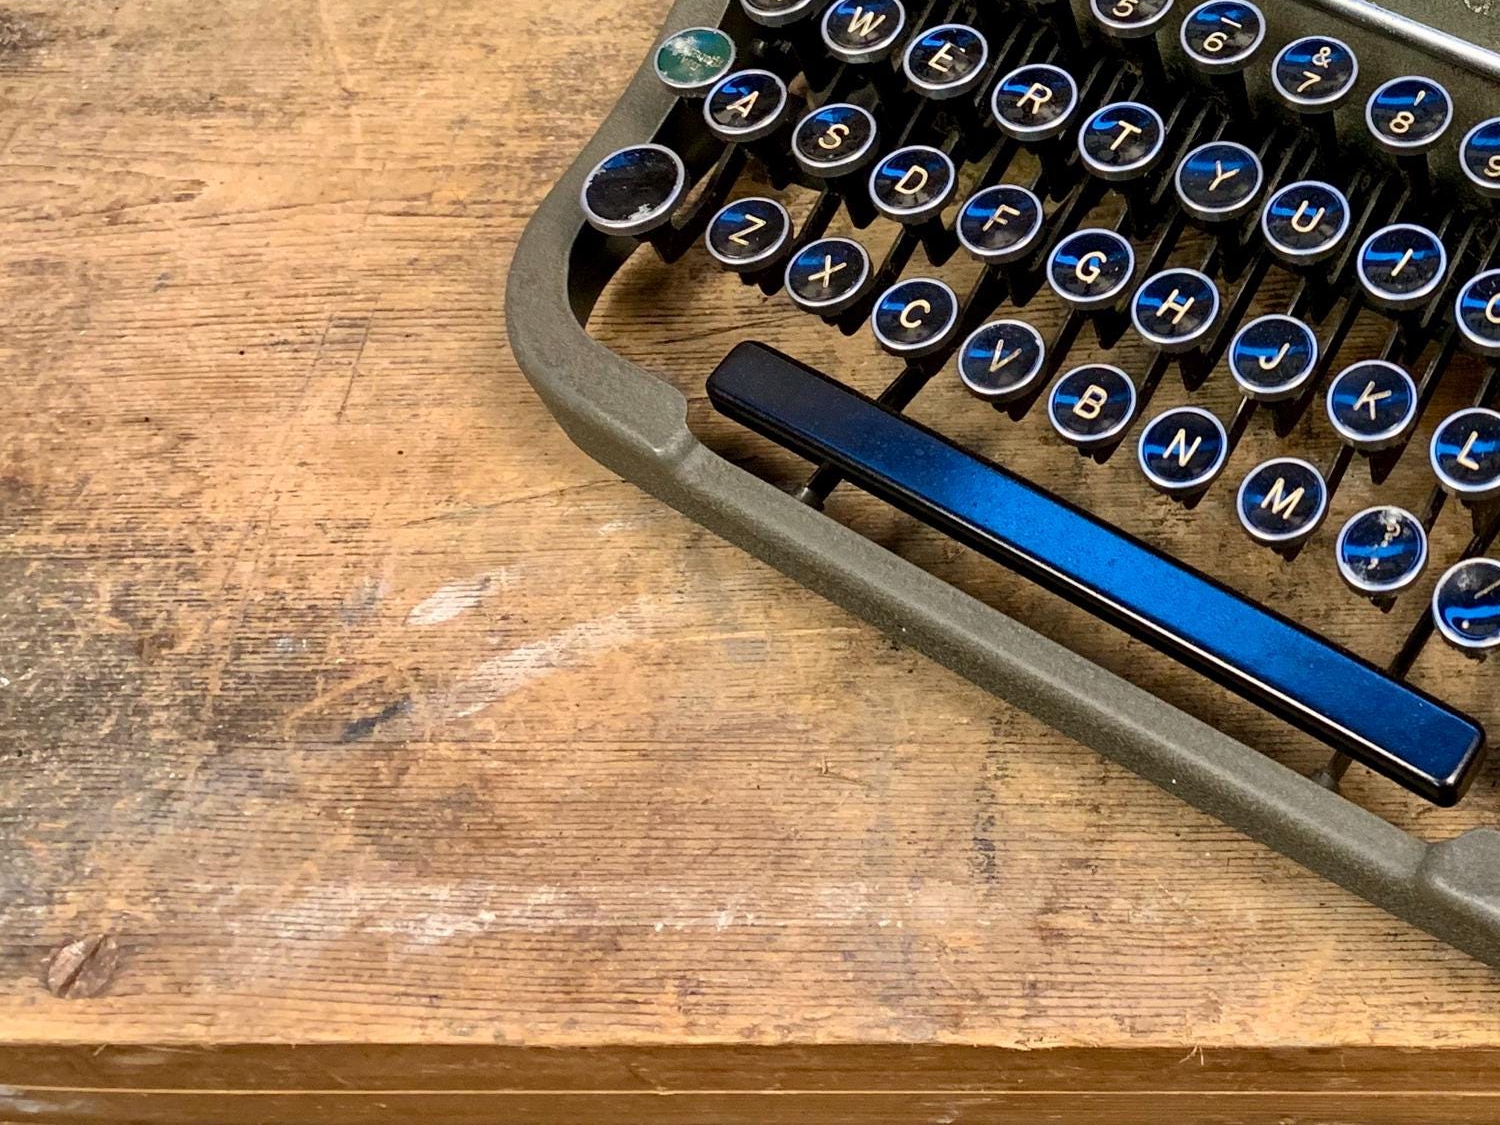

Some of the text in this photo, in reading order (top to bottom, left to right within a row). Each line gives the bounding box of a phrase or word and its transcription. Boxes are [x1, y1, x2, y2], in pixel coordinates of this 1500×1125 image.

[848, 5, 886, 38] W
[1203, 31, 1228, 52] 6
[927, 43, 957, 74] E
[1312, 46, 1332, 69] &
[1296, 70, 1322, 92] 7
[727, 88, 760, 119] A
[1016, 82, 1052, 113] R
[818, 123, 851, 151] S
[1108, 119, 1142, 151] T
[1389, 111, 1415, 134] 8
[894, 164, 927, 195] D
[1208, 160, 1239, 192] Y
[729, 215, 765, 246] Z
[982, 204, 1020, 232] F
[1291, 200, 1325, 233] U
[807, 254, 848, 287] X
[1075, 250, 1107, 283] G
[900, 299, 931, 328] C
[1156, 289, 1195, 324] H
[989, 339, 1021, 372] V
[1259, 342, 1290, 370] J
[1073, 384, 1107, 419] B
[1355, 380, 1390, 419] K
[1163, 428, 1201, 466] N
[1456, 430, 1480, 471] L
[1262, 477, 1306, 520] M
